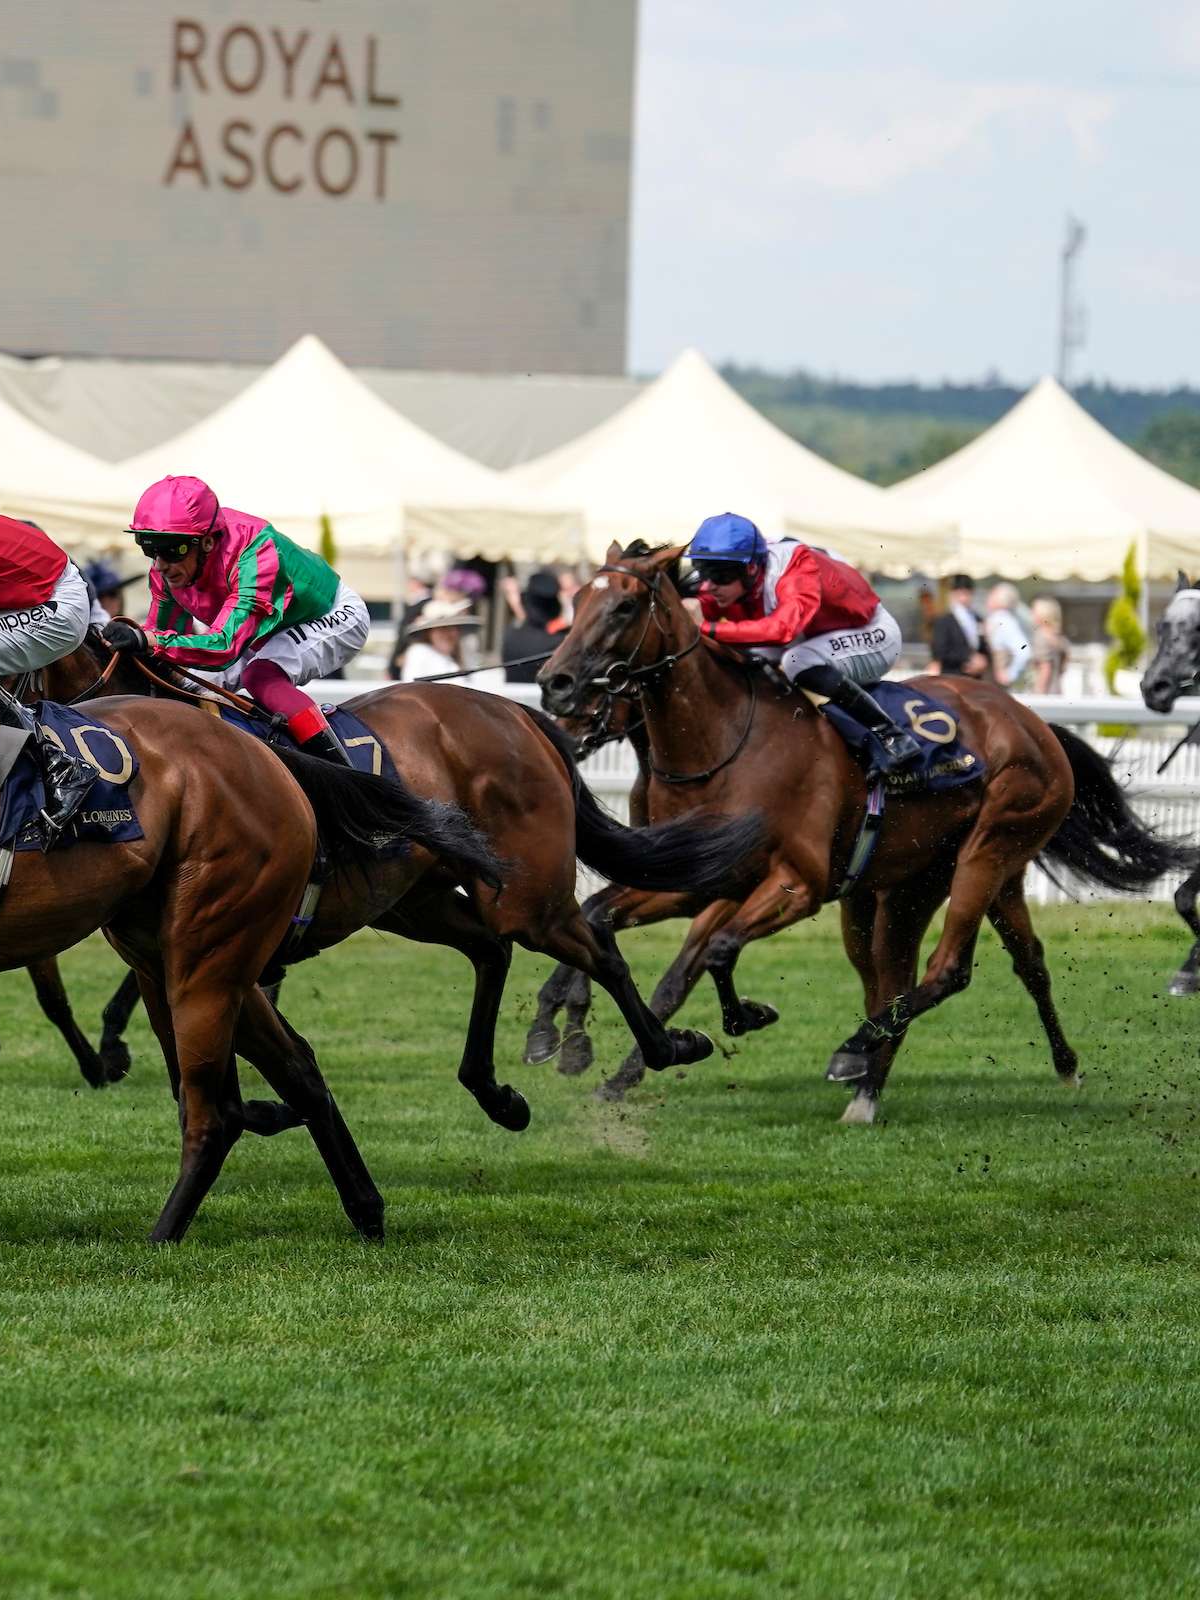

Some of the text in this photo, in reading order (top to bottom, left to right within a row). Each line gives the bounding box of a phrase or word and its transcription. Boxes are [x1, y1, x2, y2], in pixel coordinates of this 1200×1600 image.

[173, 19, 401, 107] ROYAL
[165, 119, 399, 202] ASCOT
[904, 700, 957, 744] 6
[81, 809, 132, 823] LONGINES
